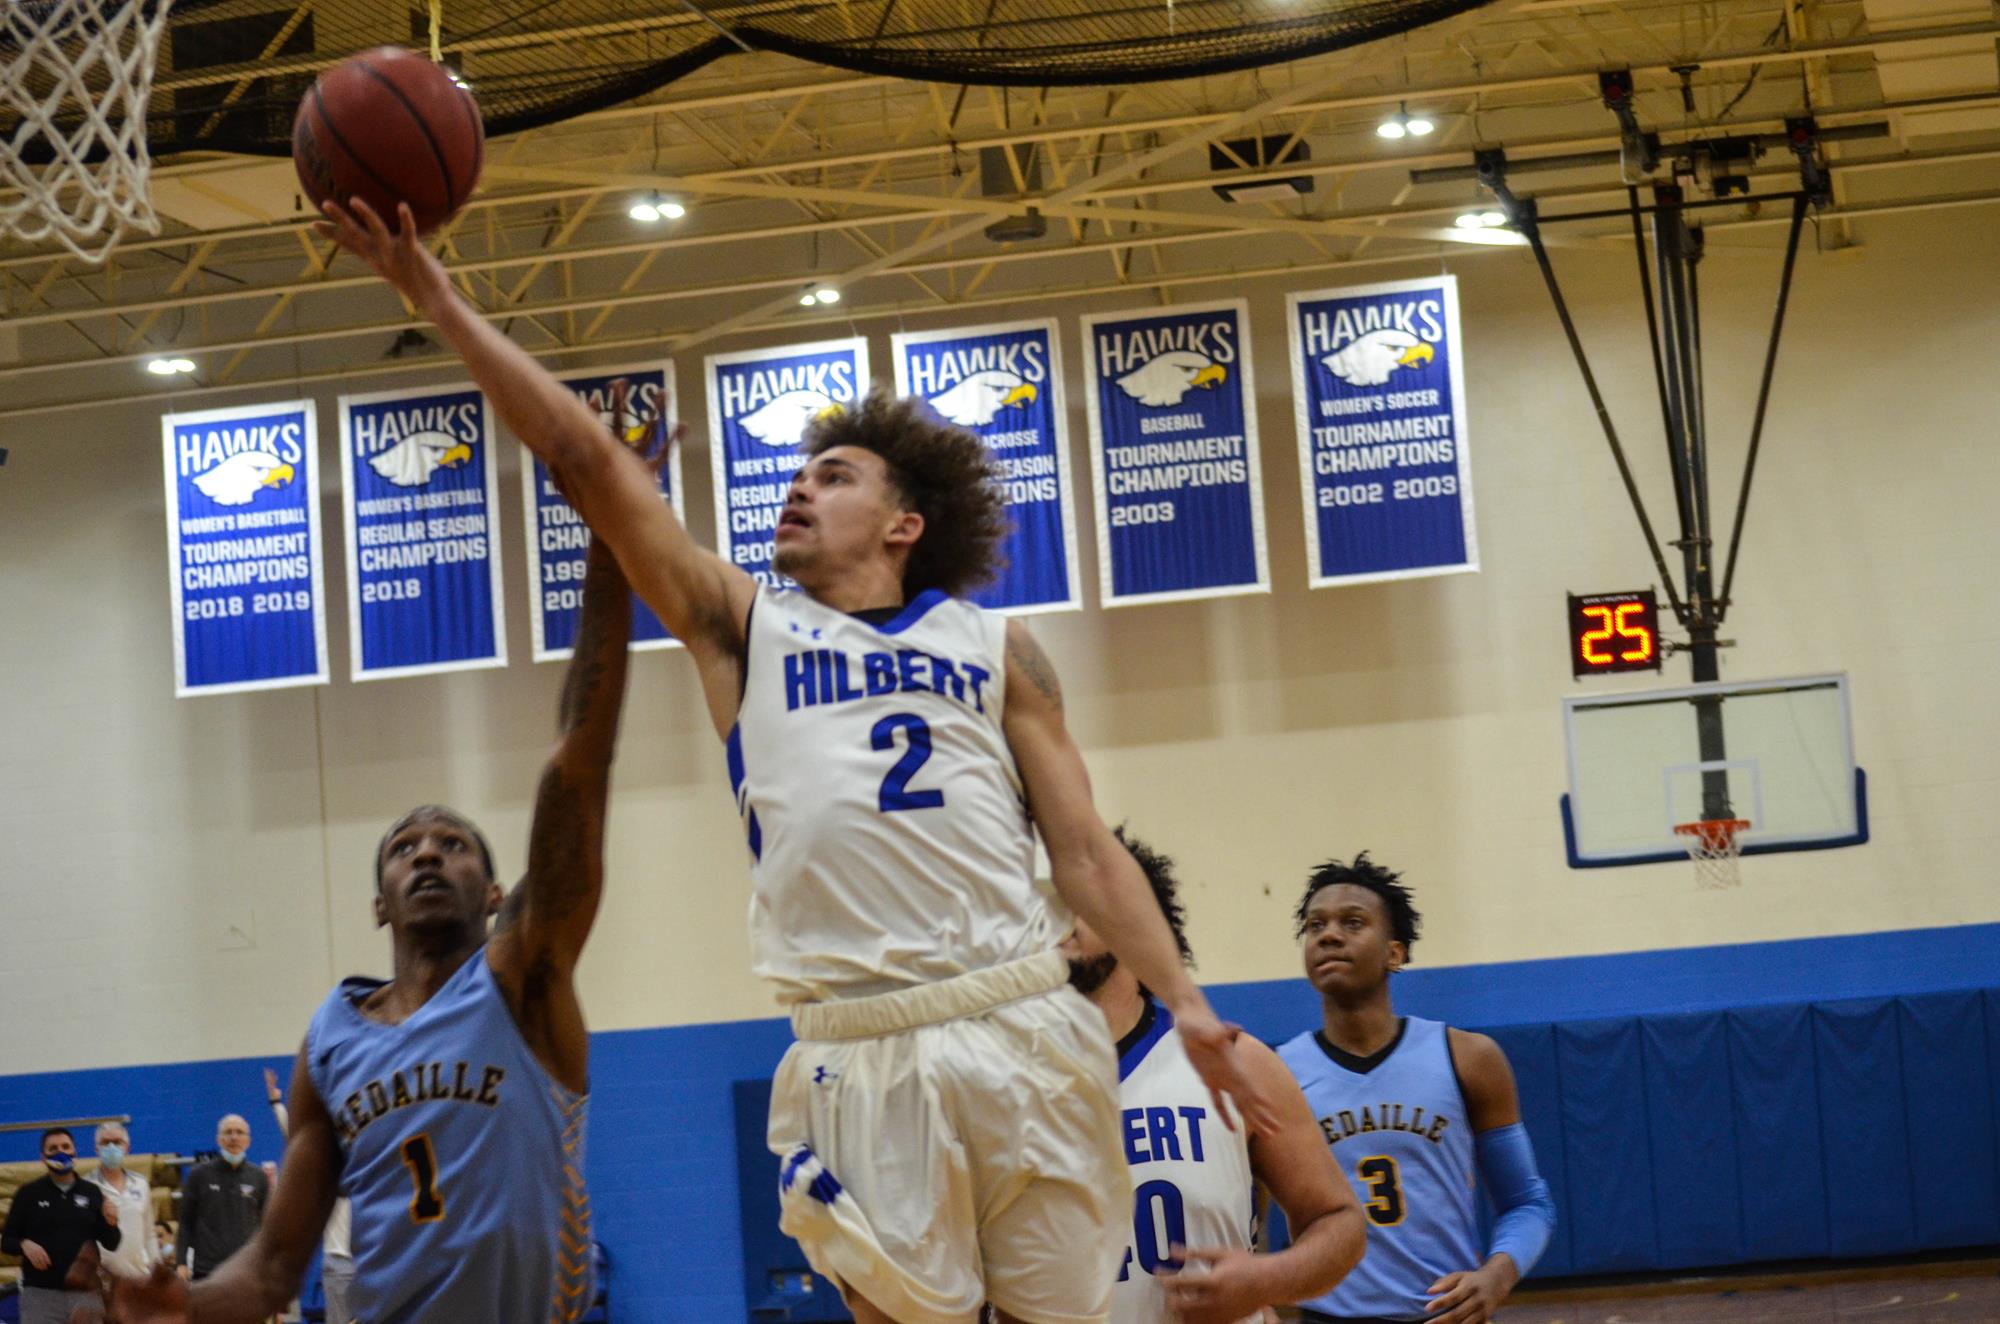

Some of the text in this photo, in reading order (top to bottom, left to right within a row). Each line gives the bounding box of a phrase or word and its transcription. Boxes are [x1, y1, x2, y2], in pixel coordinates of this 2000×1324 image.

[1304, 299, 1443, 356] HAWKS
[1101, 321, 1234, 377] HAWKS
[911, 340, 1044, 396] HAWKS
[722, 360, 855, 418] HAWKS
[1320, 389, 1440, 417] WOMEN'S SOCCER
[354, 402, 479, 457] HAWKS
[982, 428, 1040, 450] ACROSSE
[1140, 412, 1205, 435] BASEBALL
[1313, 414, 1451, 449] TOURNAMENT
[179, 422, 302, 477] HAWKS
[732, 456, 775, 477] MEN'S
[1106, 435, 1244, 469] TOURNAMENT
[1315, 440, 1455, 476] CHAMPIONS
[729, 480, 792, 508] REGULA
[1108, 458, 1247, 496] CHAMPIONS
[1318, 475, 1457, 508] 2002 2003
[357, 487, 485, 517] WOMEN'S BASKETBALL
[1110, 502, 1175, 527] 2003
[181, 507, 307, 536] WOMEN'S BASKETBALL
[358, 514, 487, 547] REGULAR SEASON
[182, 531, 308, 565] TOURNAMENT
[360, 536, 488, 572] CHAMPIONS
[184, 555, 310, 591] CHAMPIONS
[543, 560, 587, 583] 199
[185, 590, 311, 621] 2018 2019
[362, 577, 422, 603] 2018
[1580, 602, 1652, 664] 25
[784, 648, 990, 715] HILBERT
[870, 712, 945, 812] 2
[1319, 1103, 1450, 1145] EDAILLE
[402, 1132, 445, 1225] 1
[1357, 1154, 1407, 1227] 3
